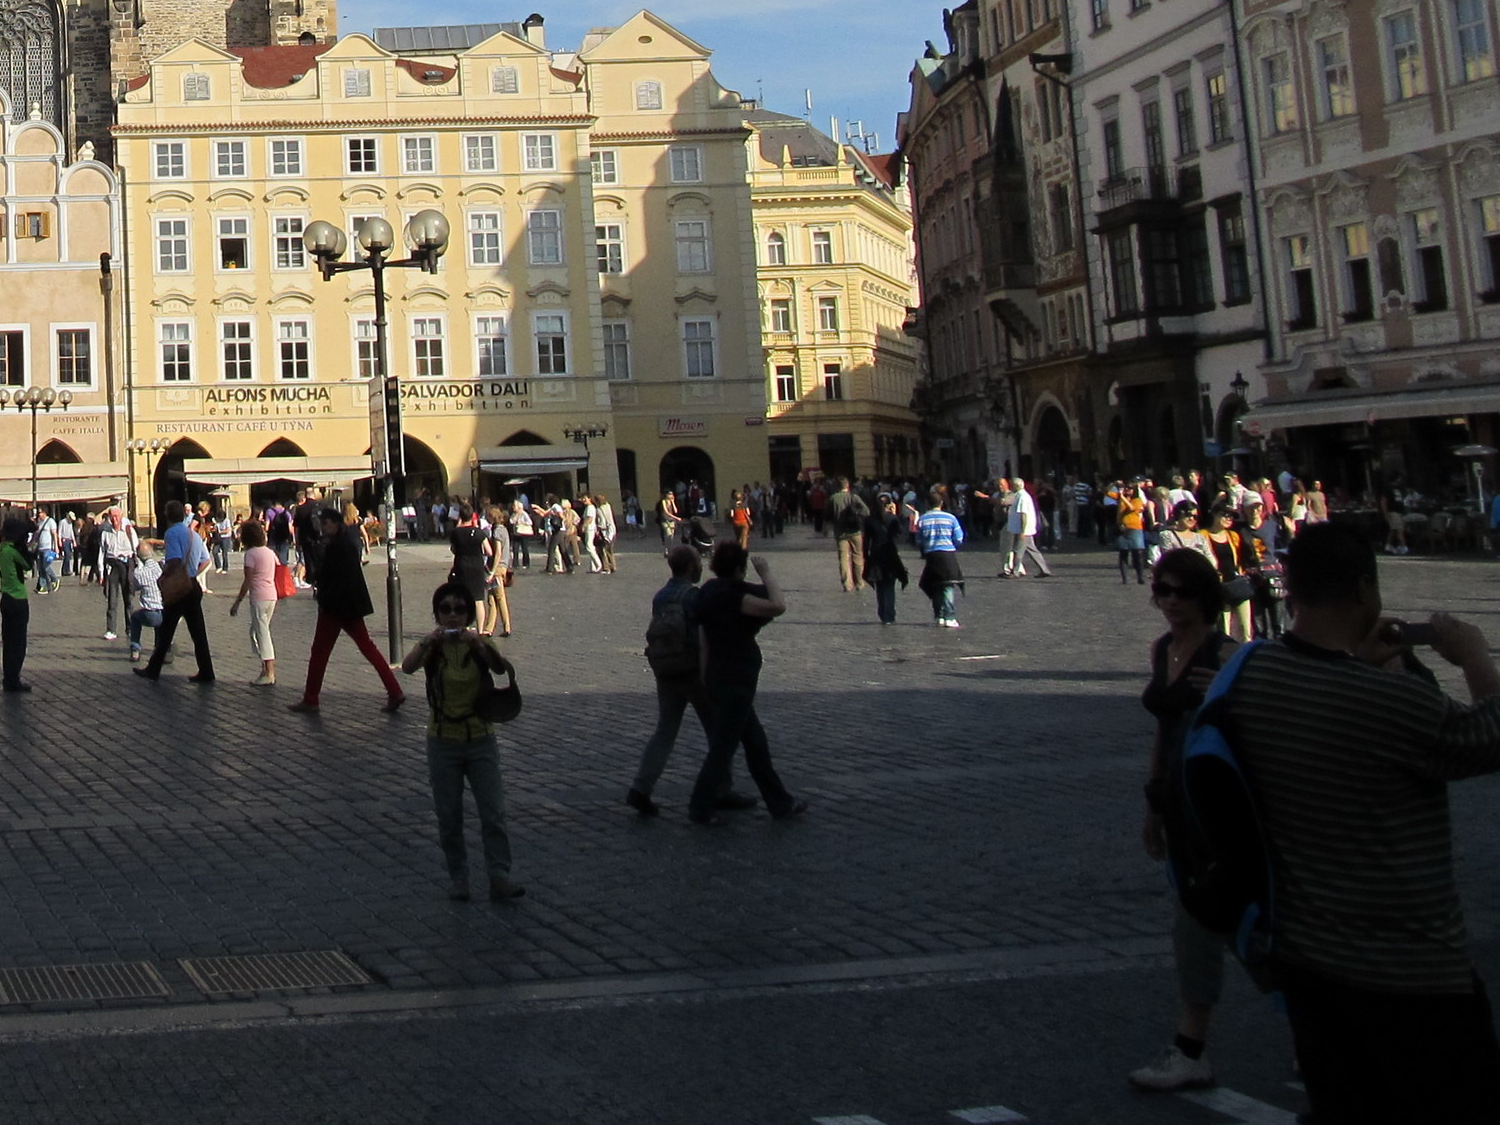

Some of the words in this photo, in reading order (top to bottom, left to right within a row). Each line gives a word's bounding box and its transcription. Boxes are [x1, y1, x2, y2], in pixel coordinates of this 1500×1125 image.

[205, 388, 267, 403] ALFONS
[271, 387, 330, 402] MUCHA
[401, 383, 485, 398] SALVADOR
[209, 404, 330, 416] exhibition
[401, 400, 529, 411] exhibition
[156, 422, 233, 433] RESTAURANT
[236, 421, 266, 432] CAFÉ
[270, 422, 278, 431] U
